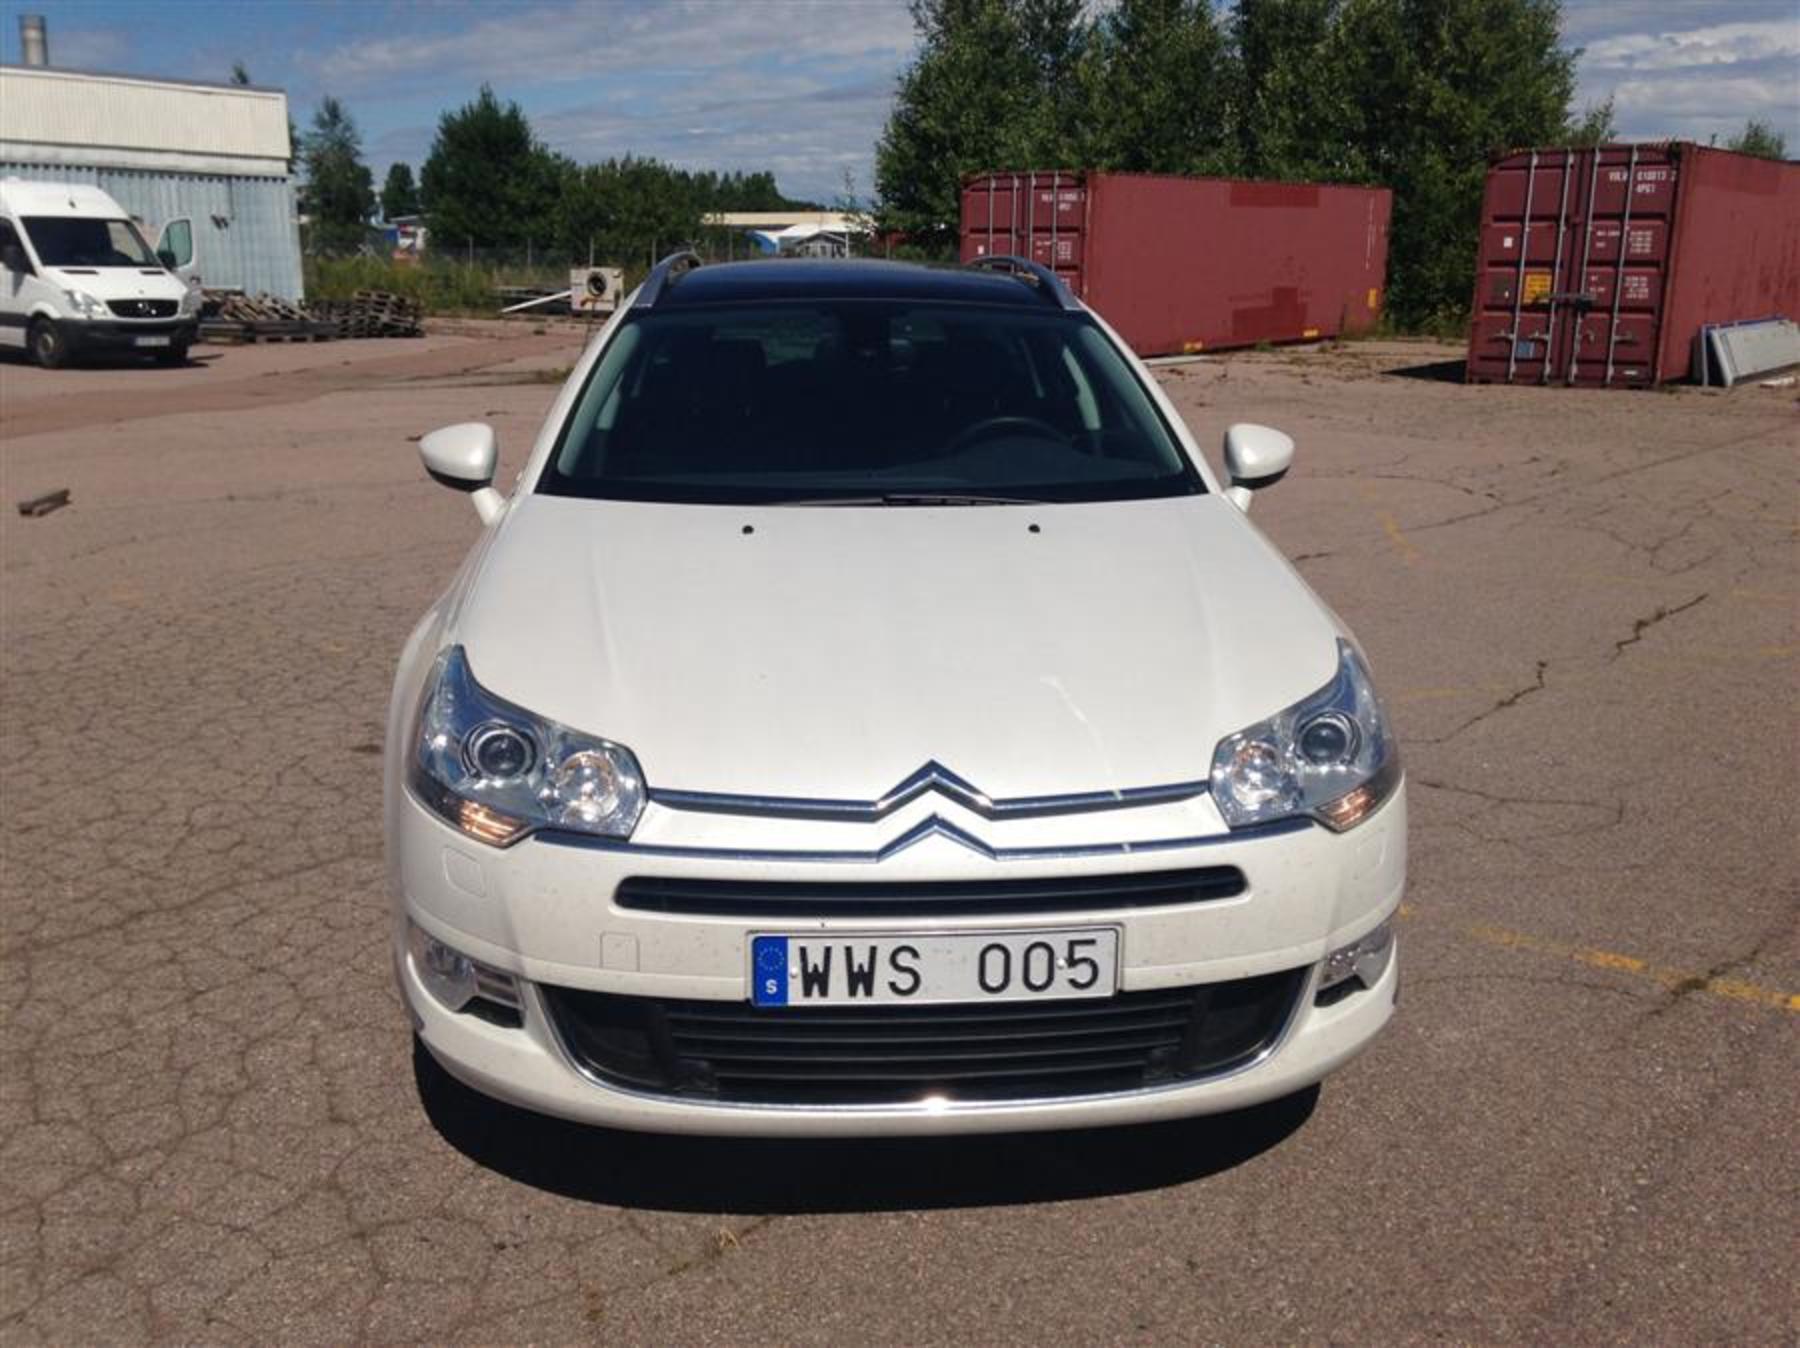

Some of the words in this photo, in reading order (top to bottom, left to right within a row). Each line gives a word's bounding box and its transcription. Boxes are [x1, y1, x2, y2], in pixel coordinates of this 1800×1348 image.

[765, 979, 778, 994] S
[799, 944, 922, 998] WWS
[977, 938, 1099, 994] 005
